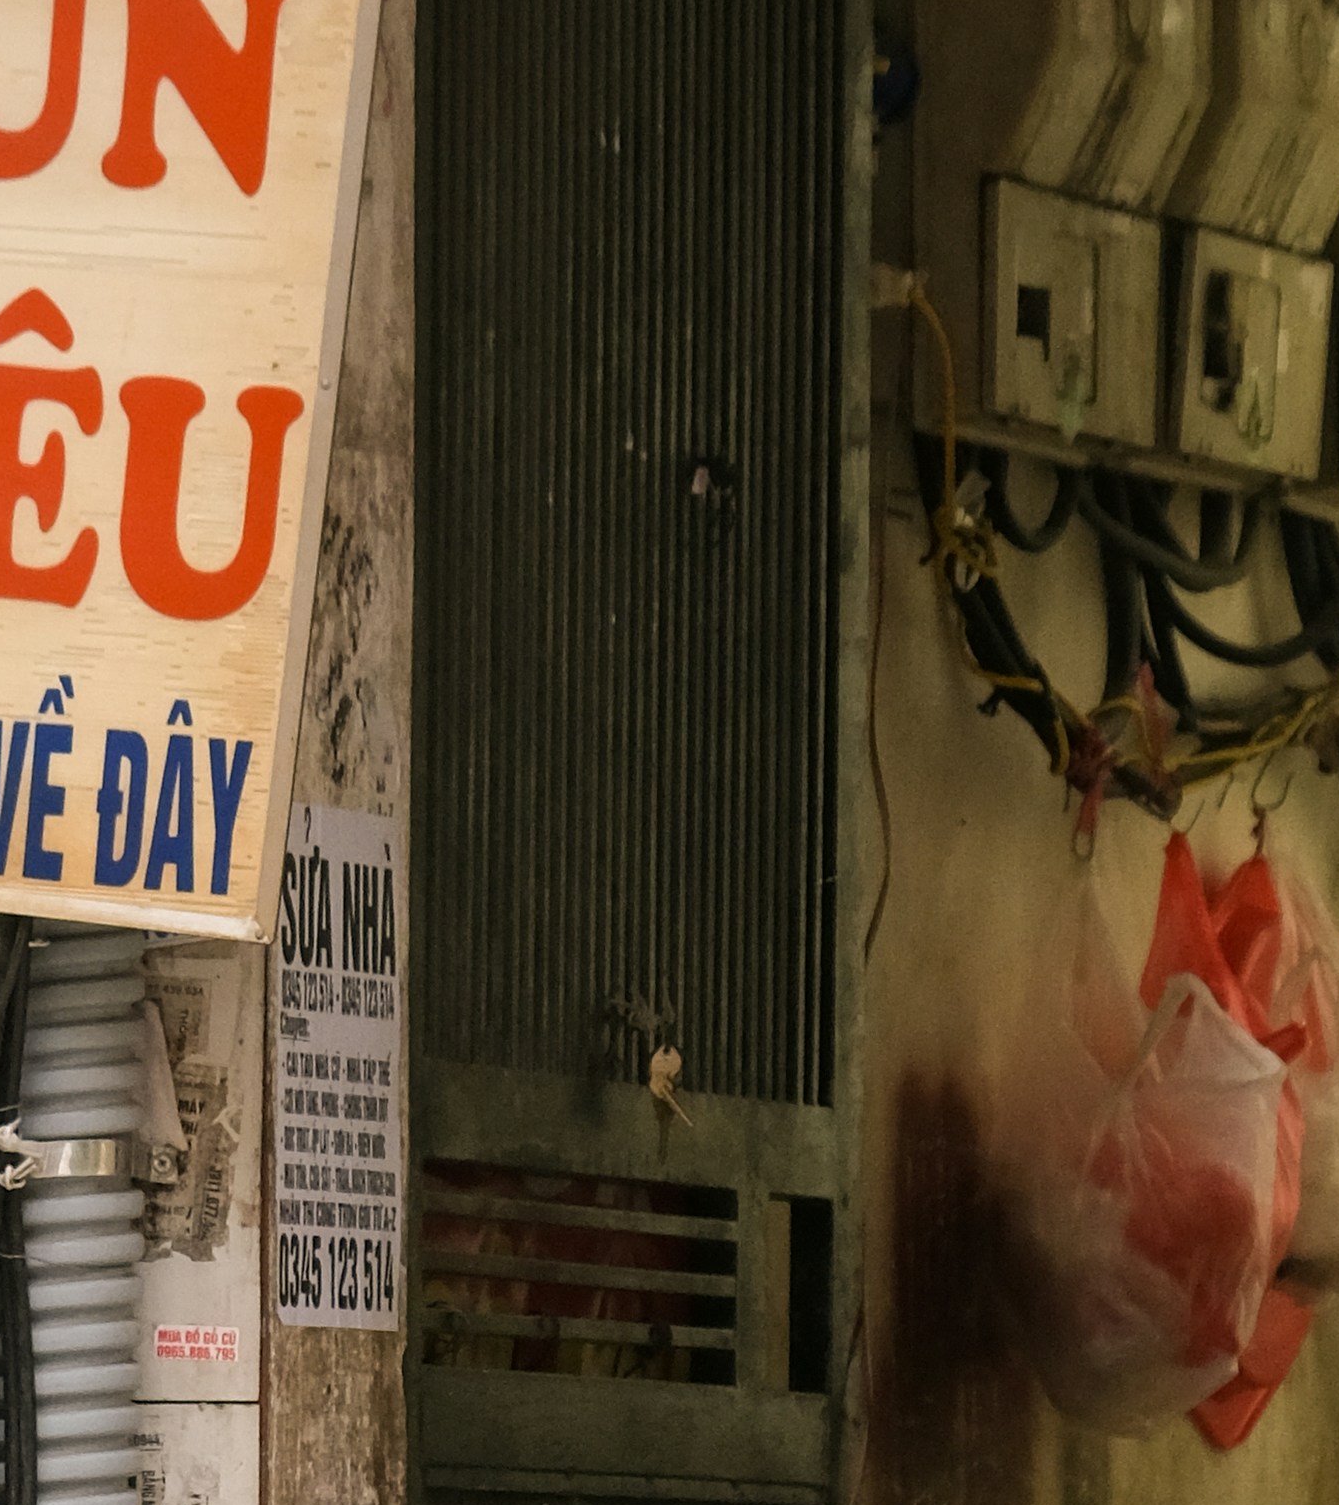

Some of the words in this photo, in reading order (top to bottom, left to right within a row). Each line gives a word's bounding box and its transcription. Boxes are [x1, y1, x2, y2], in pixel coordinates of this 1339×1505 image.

[95, 698, 256, 899] ĐÂY
[281, 805, 333, 968] SỬA
[342, 842, 396, 976] NHÀ
[280, 1233, 322, 1309] 0345
[329, 1236, 358, 1311] 123
[364, 1239, 394, 1312] 514
